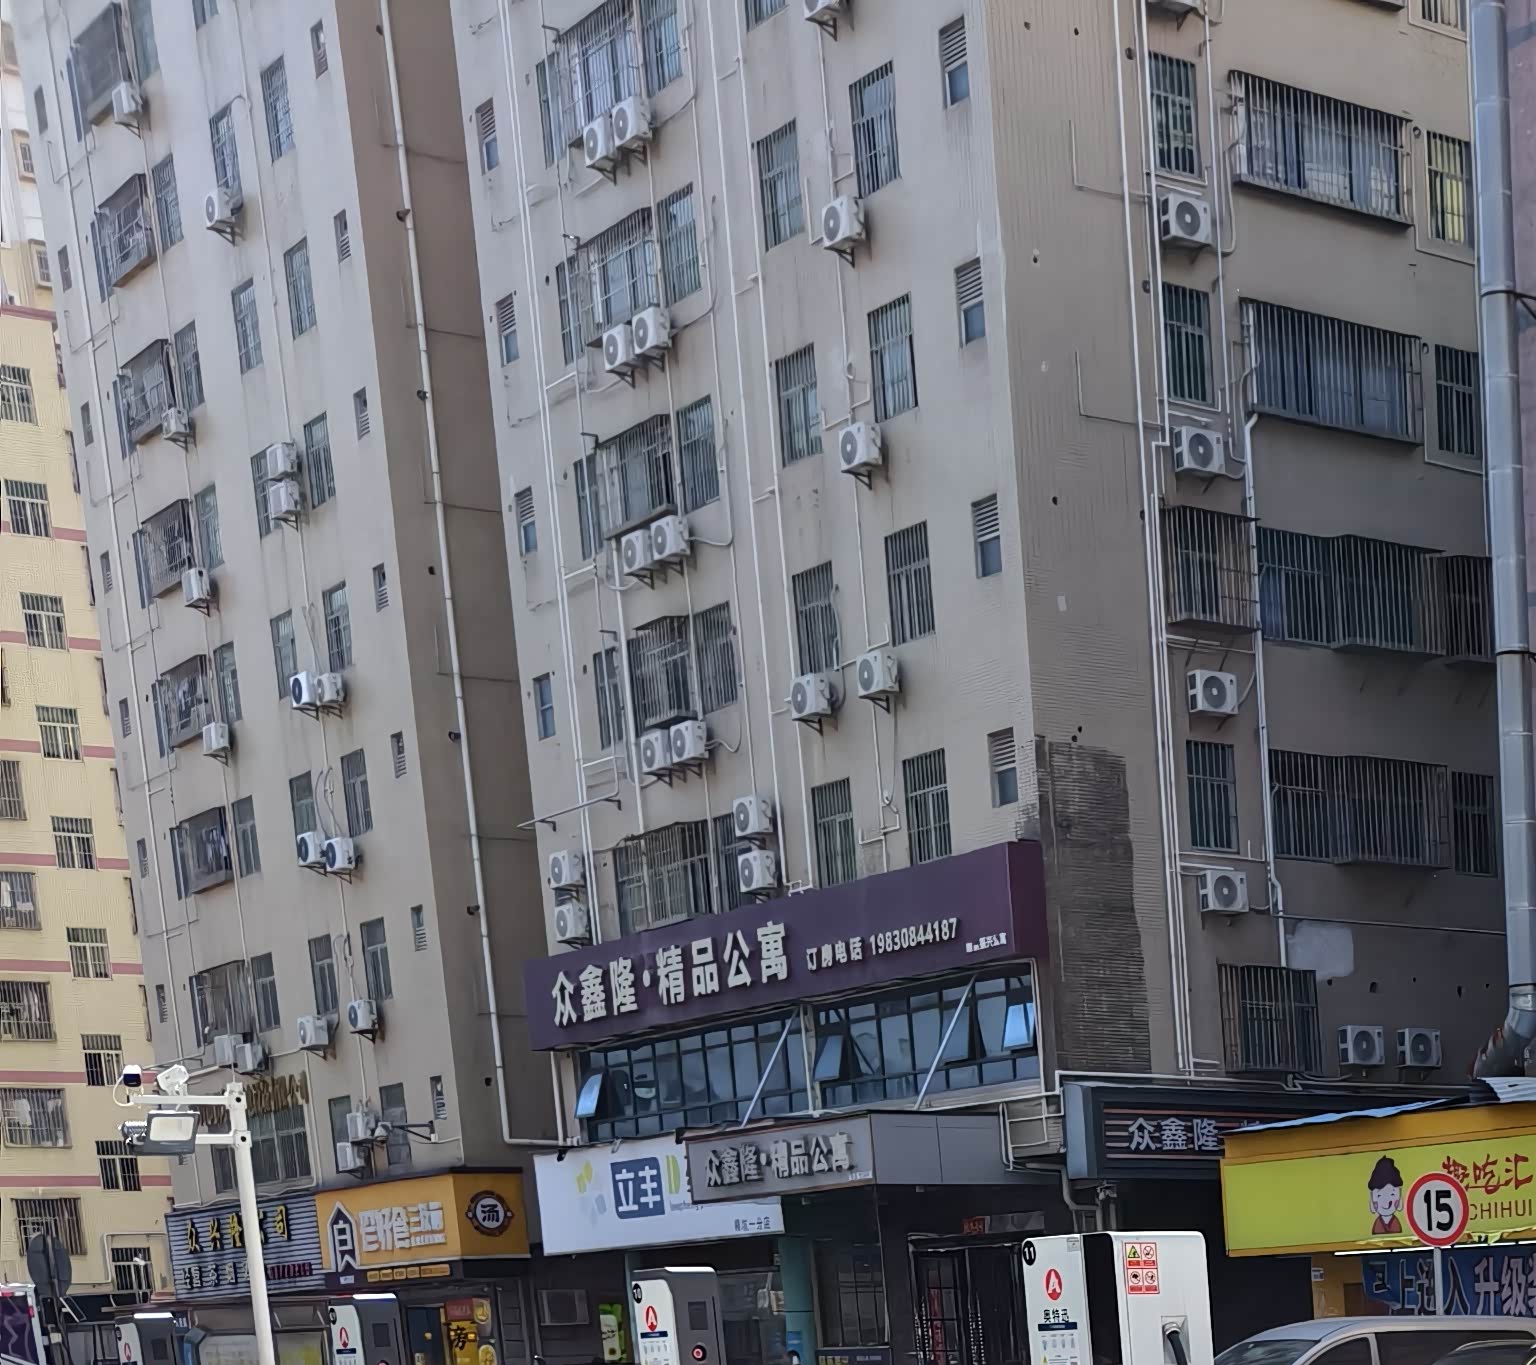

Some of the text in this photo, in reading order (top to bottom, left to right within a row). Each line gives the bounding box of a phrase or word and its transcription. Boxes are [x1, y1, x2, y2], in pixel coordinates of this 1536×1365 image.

[806, 936, 864, 971] 订房电话
[870, 917, 958, 955] 19830844187
[551, 920, 789, 1028] 众鑫隆·精品公寓
[1128, 1117, 1260, 1152] 众鑫隆
[615, 1166, 663, 1213] 立丰
[1423, 1189, 1454, 1232] 15
[1469, 1198, 1533, 1221] CHIHUI
[1024, 1246, 1035, 1261] 11
